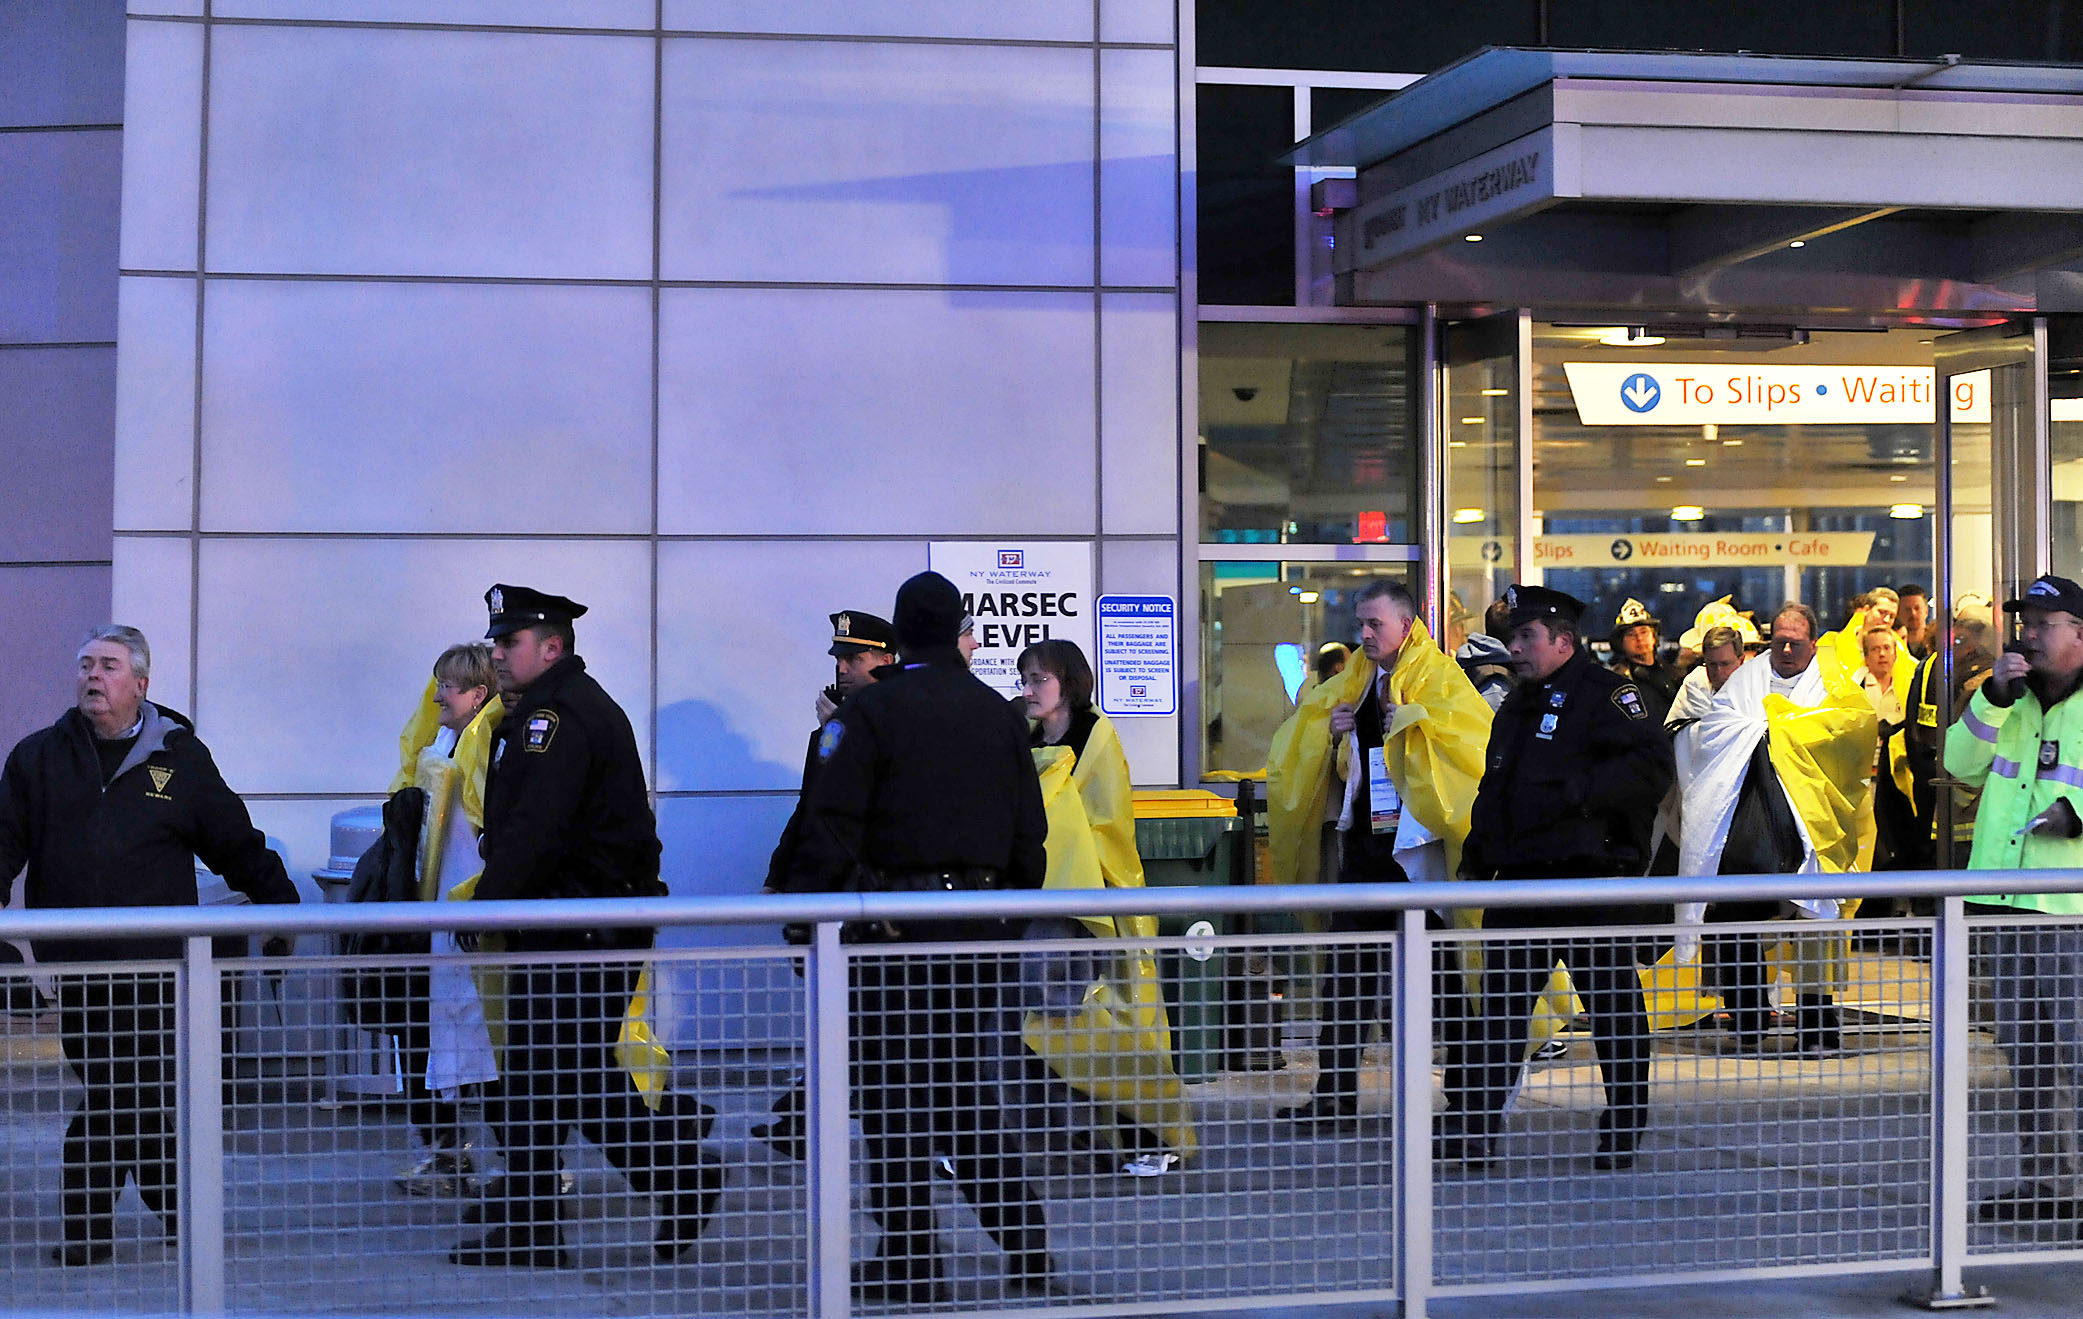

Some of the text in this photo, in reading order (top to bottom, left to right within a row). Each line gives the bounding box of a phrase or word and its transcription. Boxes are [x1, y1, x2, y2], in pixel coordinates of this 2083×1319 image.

[1443, 152, 1539, 213] WATERWAY
[1675, 375, 1975, 411] To Slips Waitig
[1534, 542, 1574, 559] Slips
[1639, 541, 1710, 560] Waiting
[1716, 541, 1768, 556] Room
[1788, 540, 1829, 556] Cafe
[1101, 603, 1171, 612] SECURITY NOTICE
[1630, 608, 1639, 617] 4
